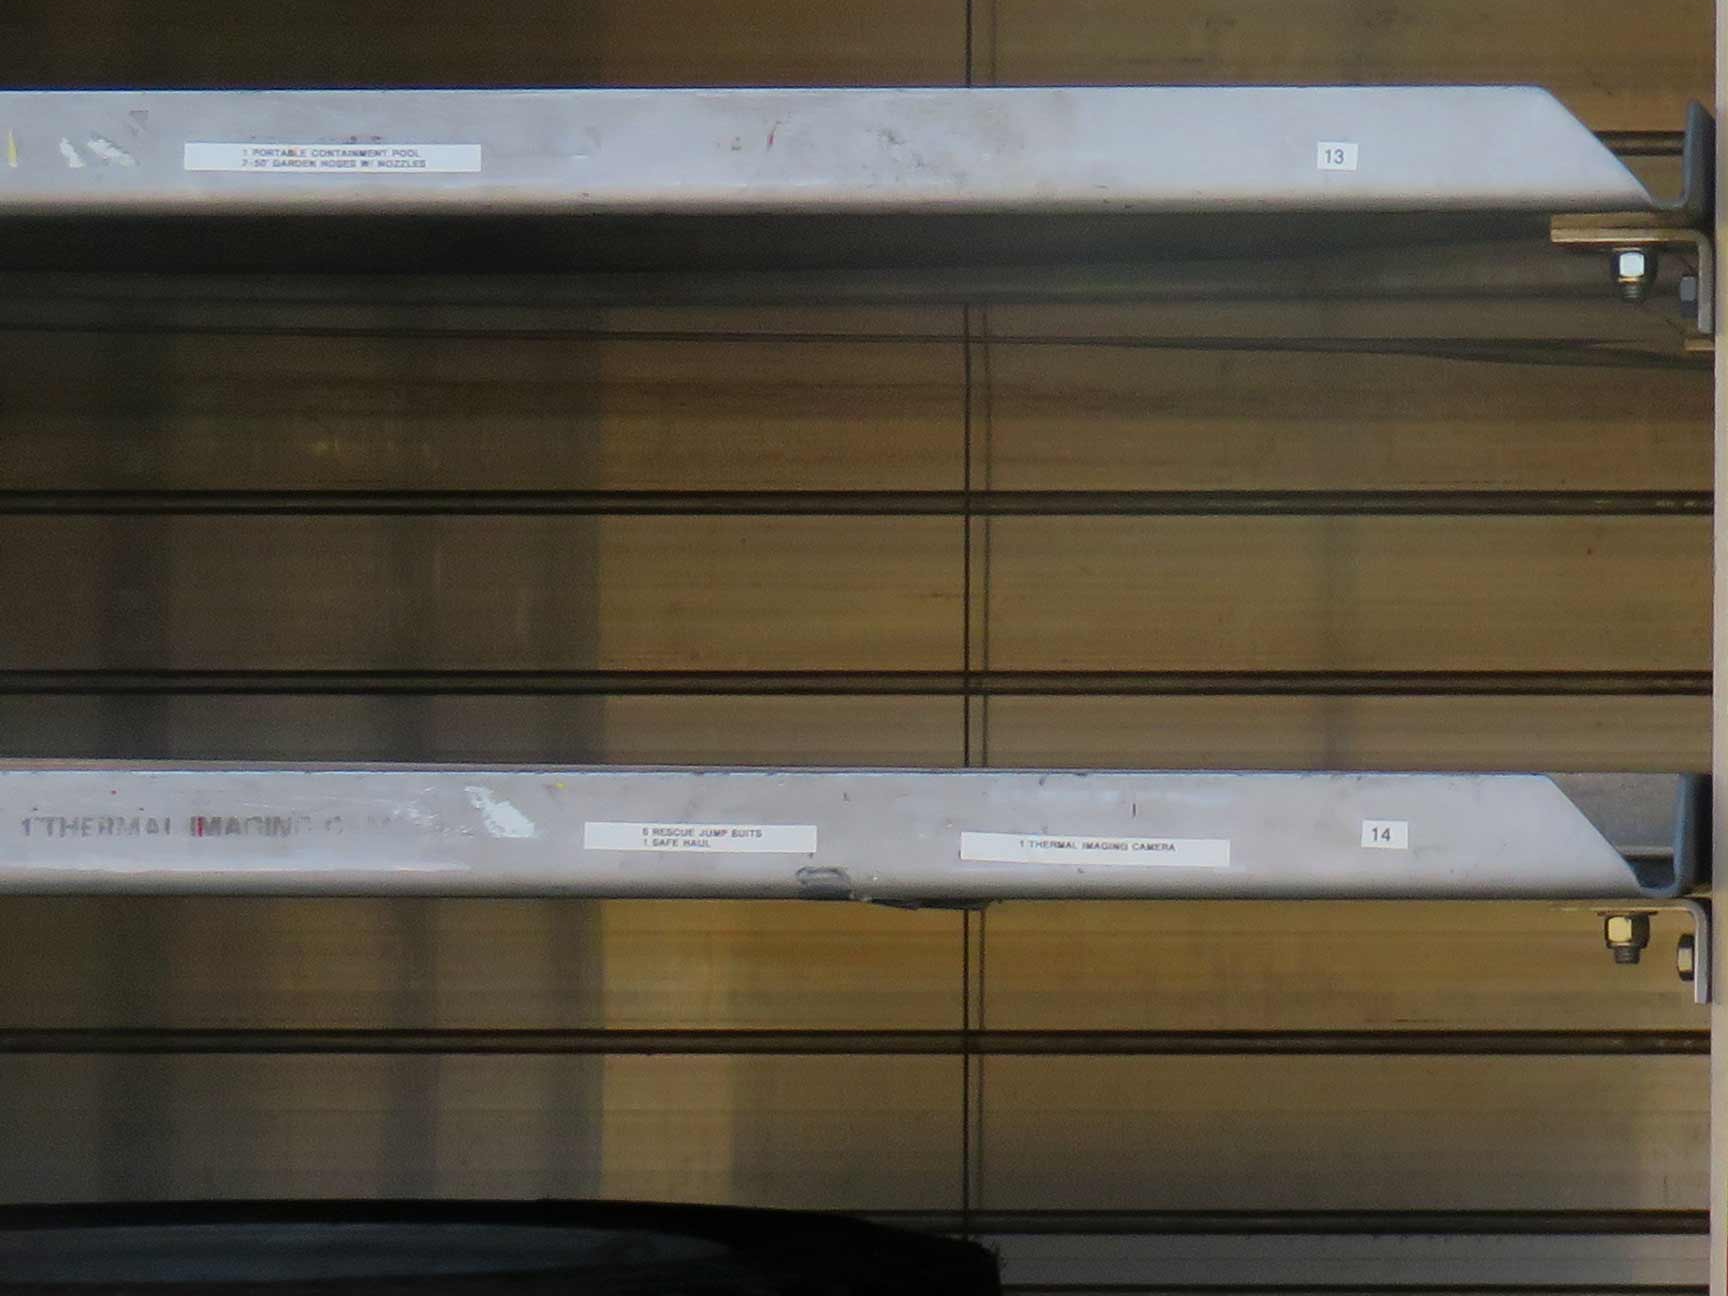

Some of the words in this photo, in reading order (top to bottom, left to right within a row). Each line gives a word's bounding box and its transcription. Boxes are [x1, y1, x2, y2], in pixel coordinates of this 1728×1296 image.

[311, 148, 388, 158] CONTAINMENT
[392, 148, 421, 158] POOL
[1324, 147, 1345, 165] 13
[377, 159, 427, 169] NOZZLES
[652, 828, 694, 837] RESCUE
[698, 829, 728, 837] JUMP
[731, 829, 763, 838] SUITS
[1372, 826, 1391, 842] 14
[652, 839, 679, 847] SAFE
[1029, 841, 1078, 849] THERMAL
[1082, 842, 1129, 851] IMAGING
[1132, 843, 1176, 852] CAMERA
